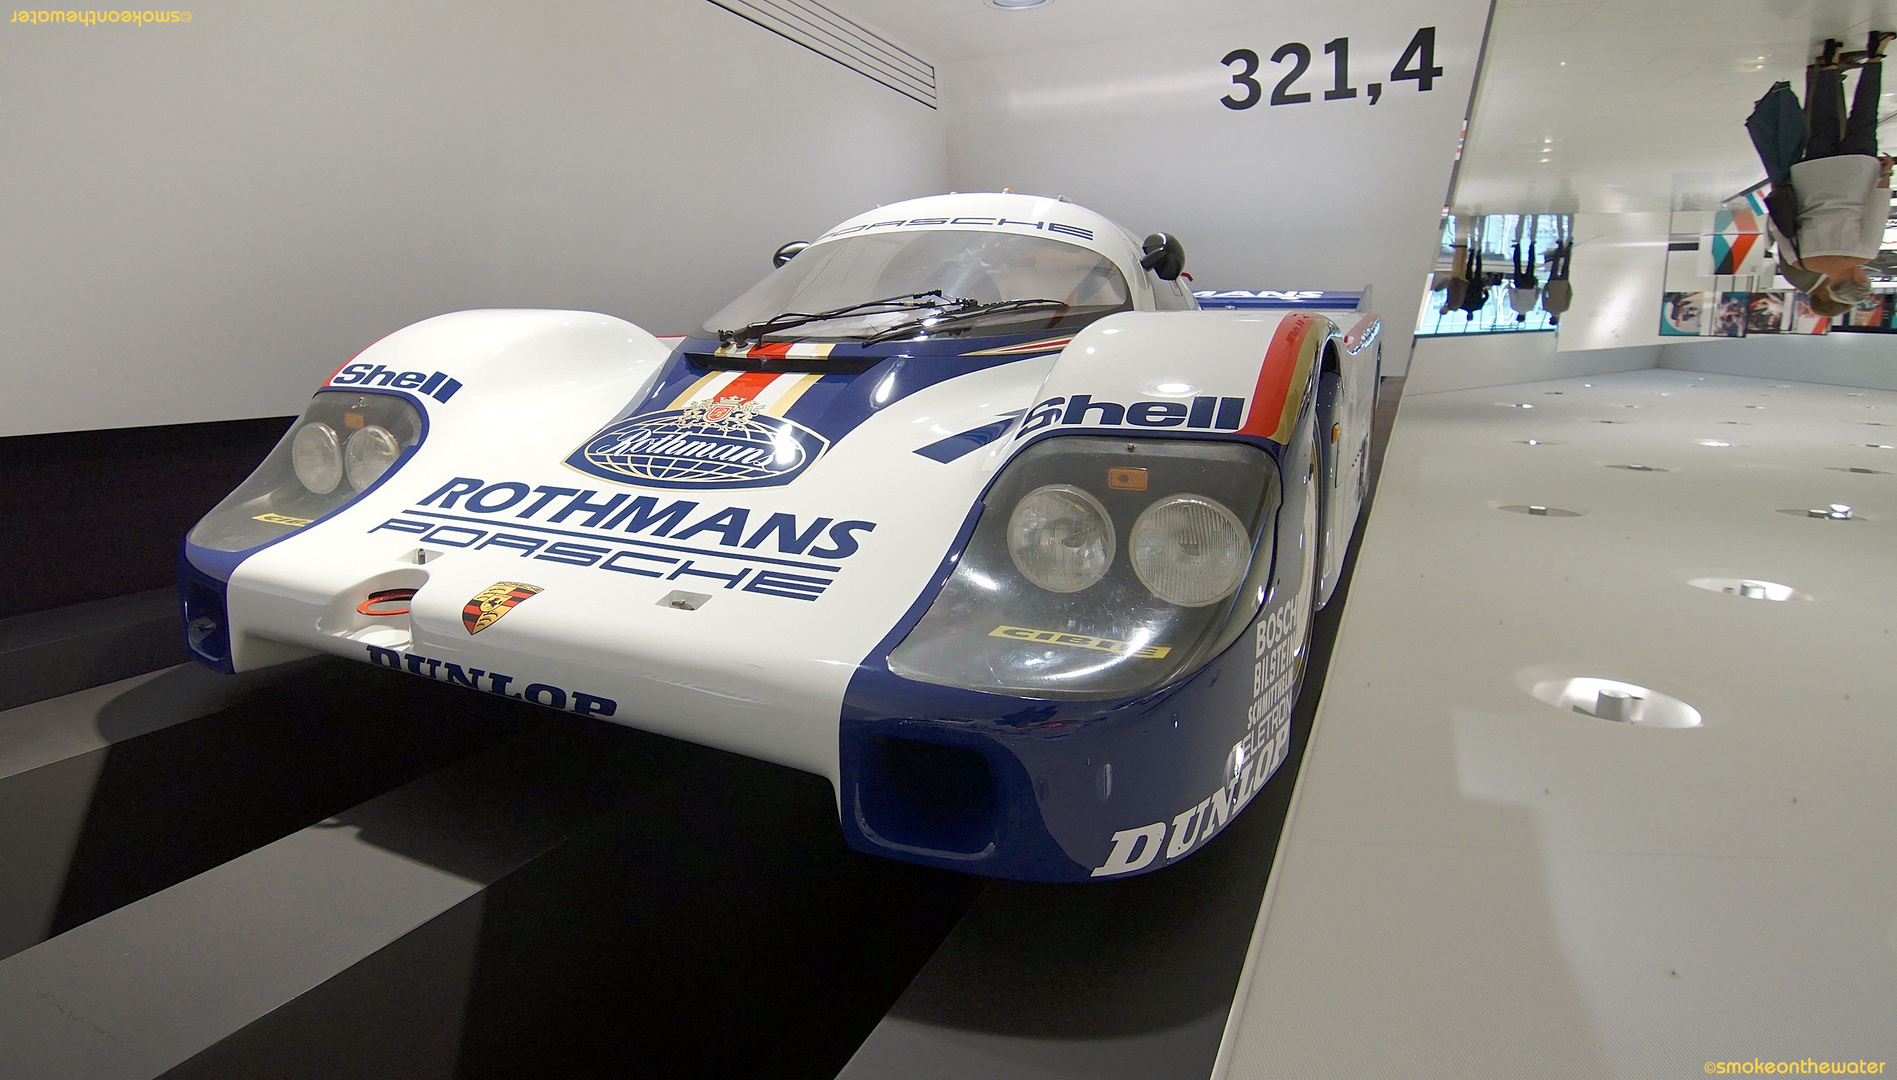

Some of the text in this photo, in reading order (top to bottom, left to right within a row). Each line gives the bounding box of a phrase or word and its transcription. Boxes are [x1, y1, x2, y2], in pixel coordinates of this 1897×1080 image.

[1219, 26, 1443, 111] 321,4
[333, 363, 463, 404] Shell
[1015, 394, 1245, 438] Shell
[595, 427, 778, 472] Rothmans
[416, 476, 877, 559] ROTHMANS
[367, 518, 834, 602] PORSCHE
[1256, 594, 1298, 659] BOSCH
[366, 645, 618, 717] DUNLOP
[1253, 631, 1297, 698] BILSTEIN
[1090, 718, 1290, 877] DUNLOP
